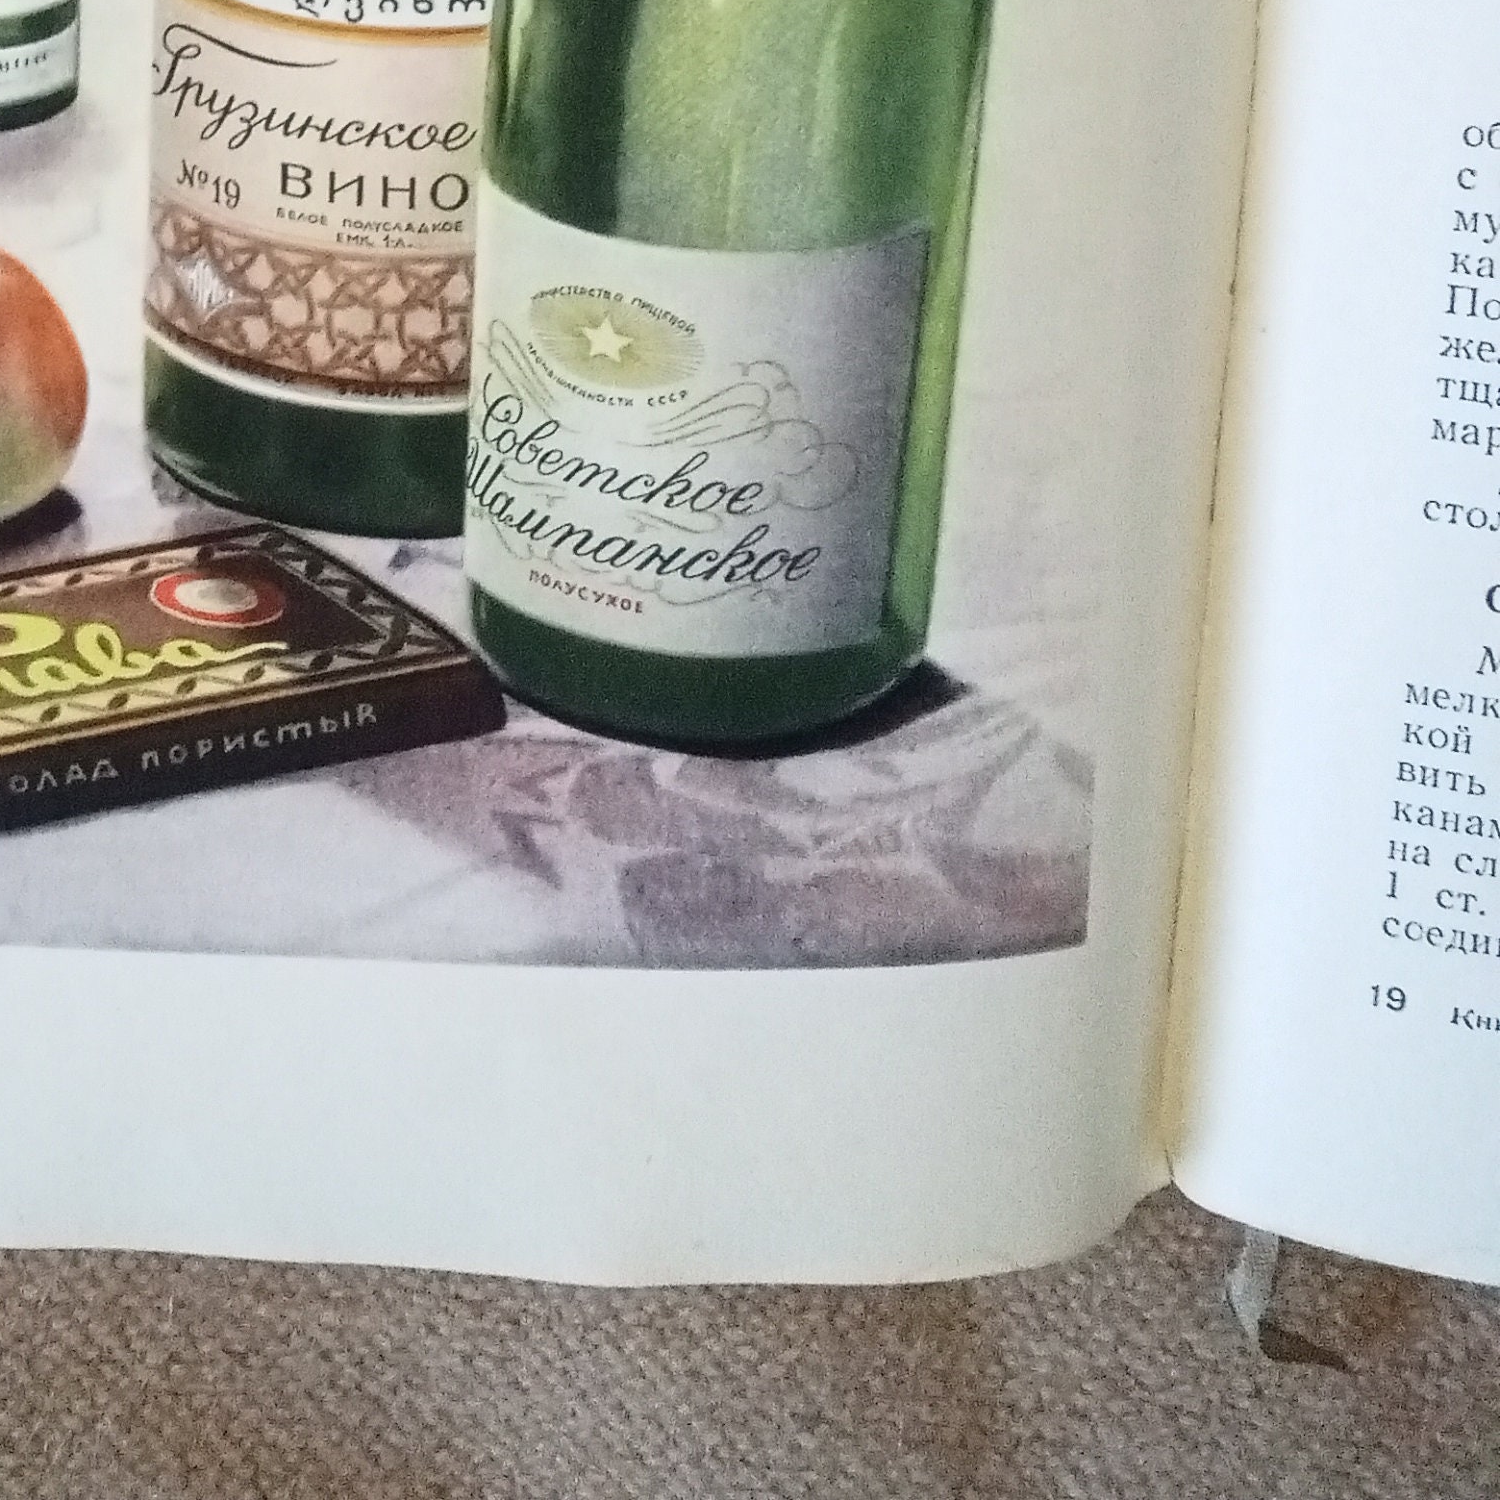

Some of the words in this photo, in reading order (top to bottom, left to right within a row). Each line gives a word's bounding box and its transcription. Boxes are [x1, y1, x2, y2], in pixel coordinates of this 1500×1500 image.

[152, 23, 478, 151] Грузинское
[280, 161, 470, 212] ВИНО
[1449, 252, 1495, 279] ка
[1438, 334, 1500, 364] же
[1435, 376, 1500, 408] тщ
[482, 372, 765, 516] Советское
[468, 437, 823, 583] Шампанское
[528, 569, 645, 614] ПОЛУСУХОЕ
[1404, 682, 1500, 719] мелк
[1402, 721, 1473, 755] кой
[1395, 760, 1486, 796] вить
[1386, 839, 1431, 867] на
[1435, 888, 1486, 916] ст.
[1382, 915, 1500, 958] соеди
[1371, 983, 1407, 1012] 19
[1449, 1006, 1500, 1032] Кн
